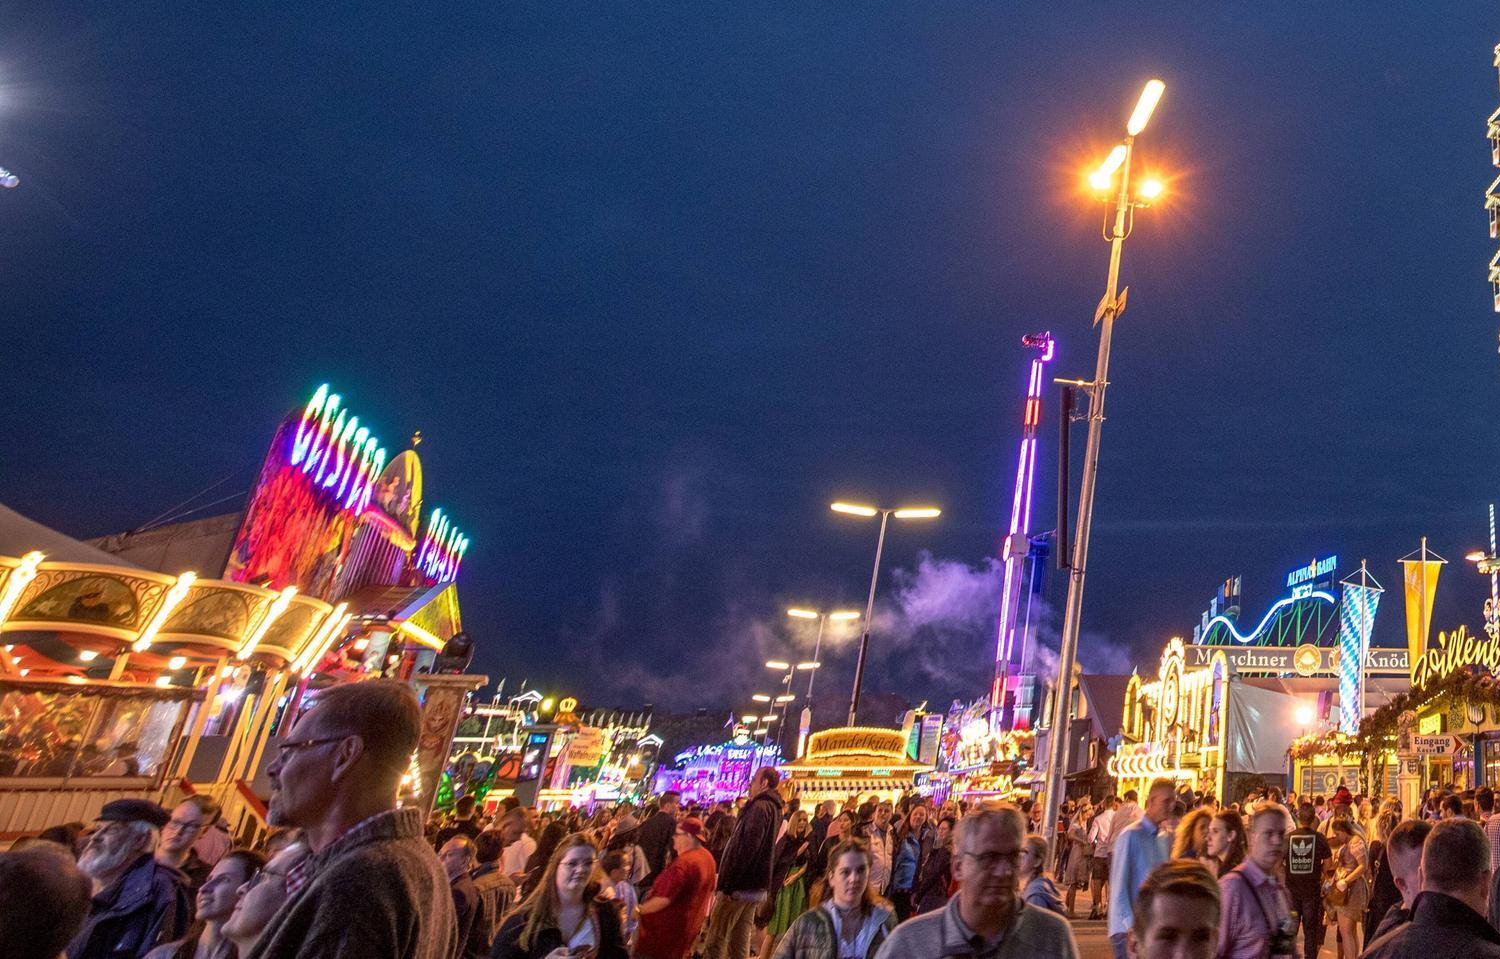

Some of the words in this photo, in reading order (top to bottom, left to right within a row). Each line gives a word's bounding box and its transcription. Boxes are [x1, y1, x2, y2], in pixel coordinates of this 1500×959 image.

[1196, 648, 1287, 667] Mchner
[1366, 651, 1409, 668] Knöd
[812, 735, 904, 753] Mandelküche
[1414, 736, 1450, 747] Eingang
